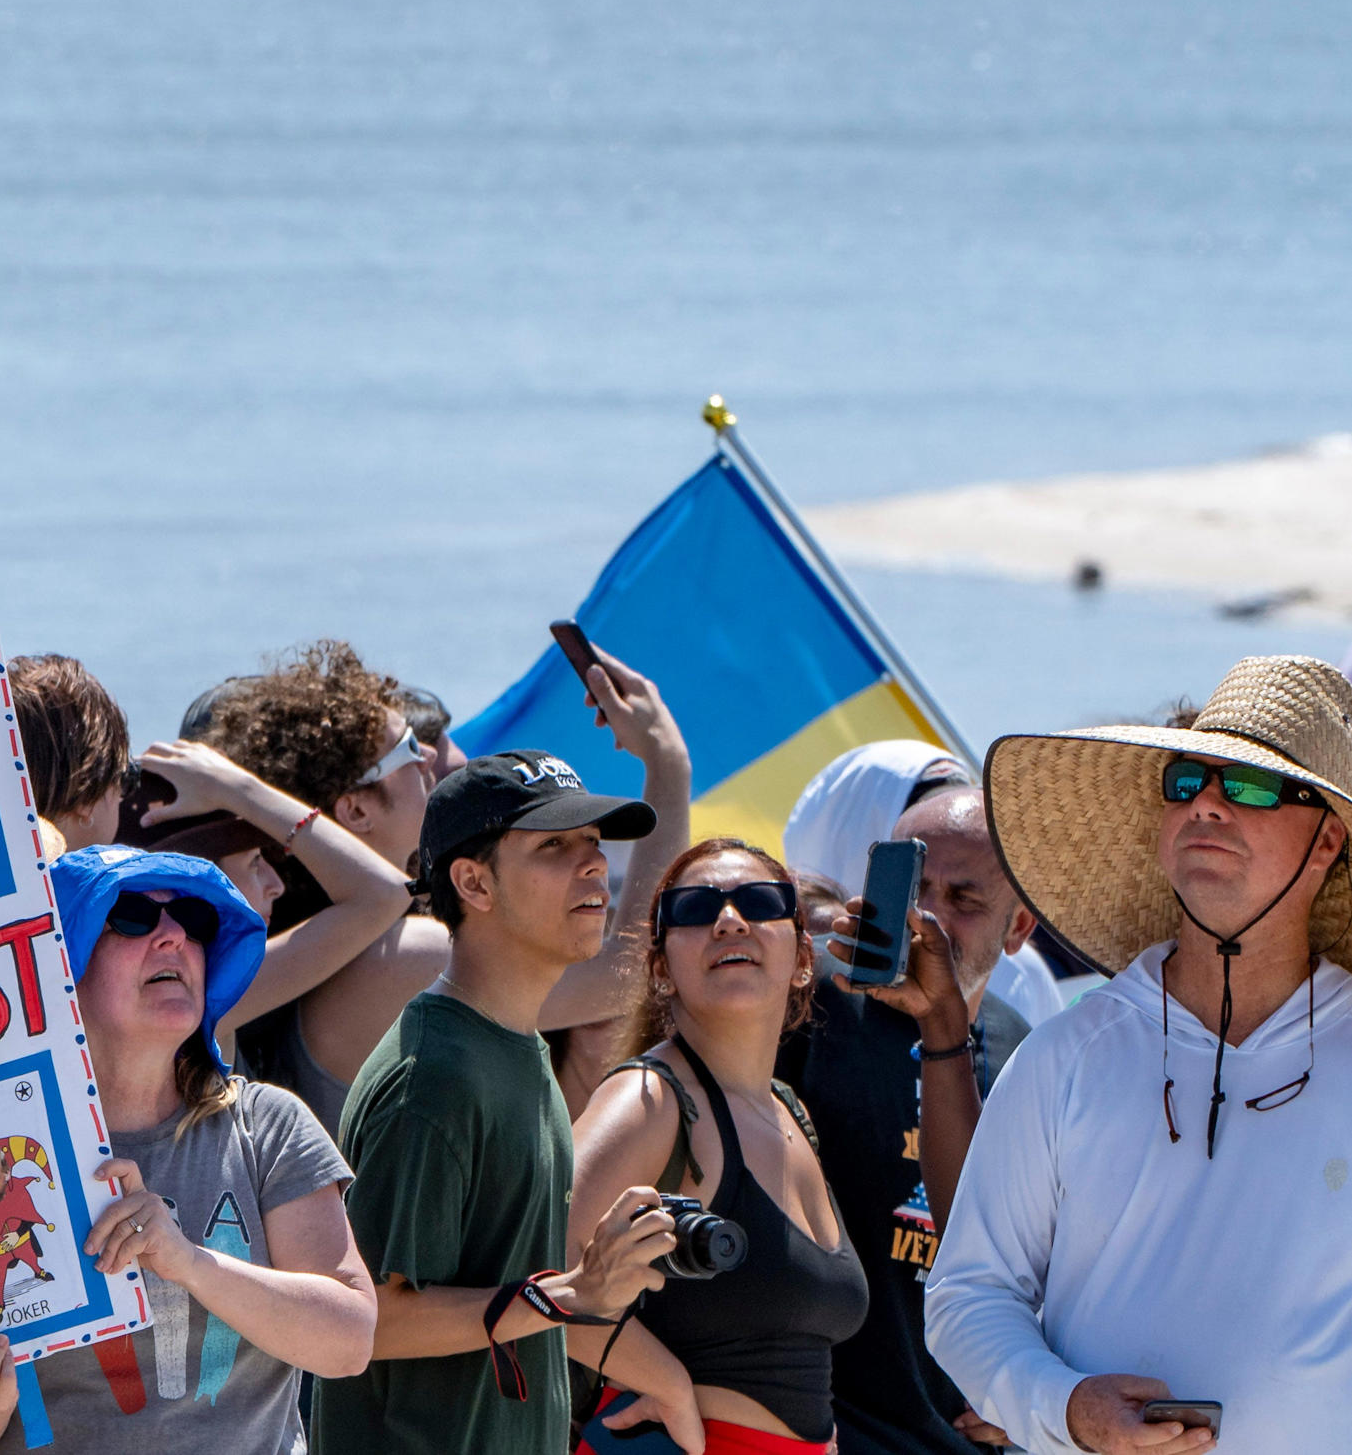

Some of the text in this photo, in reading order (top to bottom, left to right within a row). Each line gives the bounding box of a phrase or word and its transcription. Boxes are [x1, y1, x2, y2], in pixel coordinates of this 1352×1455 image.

[891, 1227, 938, 1269] VET
[6, 1299, 51, 1327] JOKER
[525, 1286, 551, 1315] Canon
